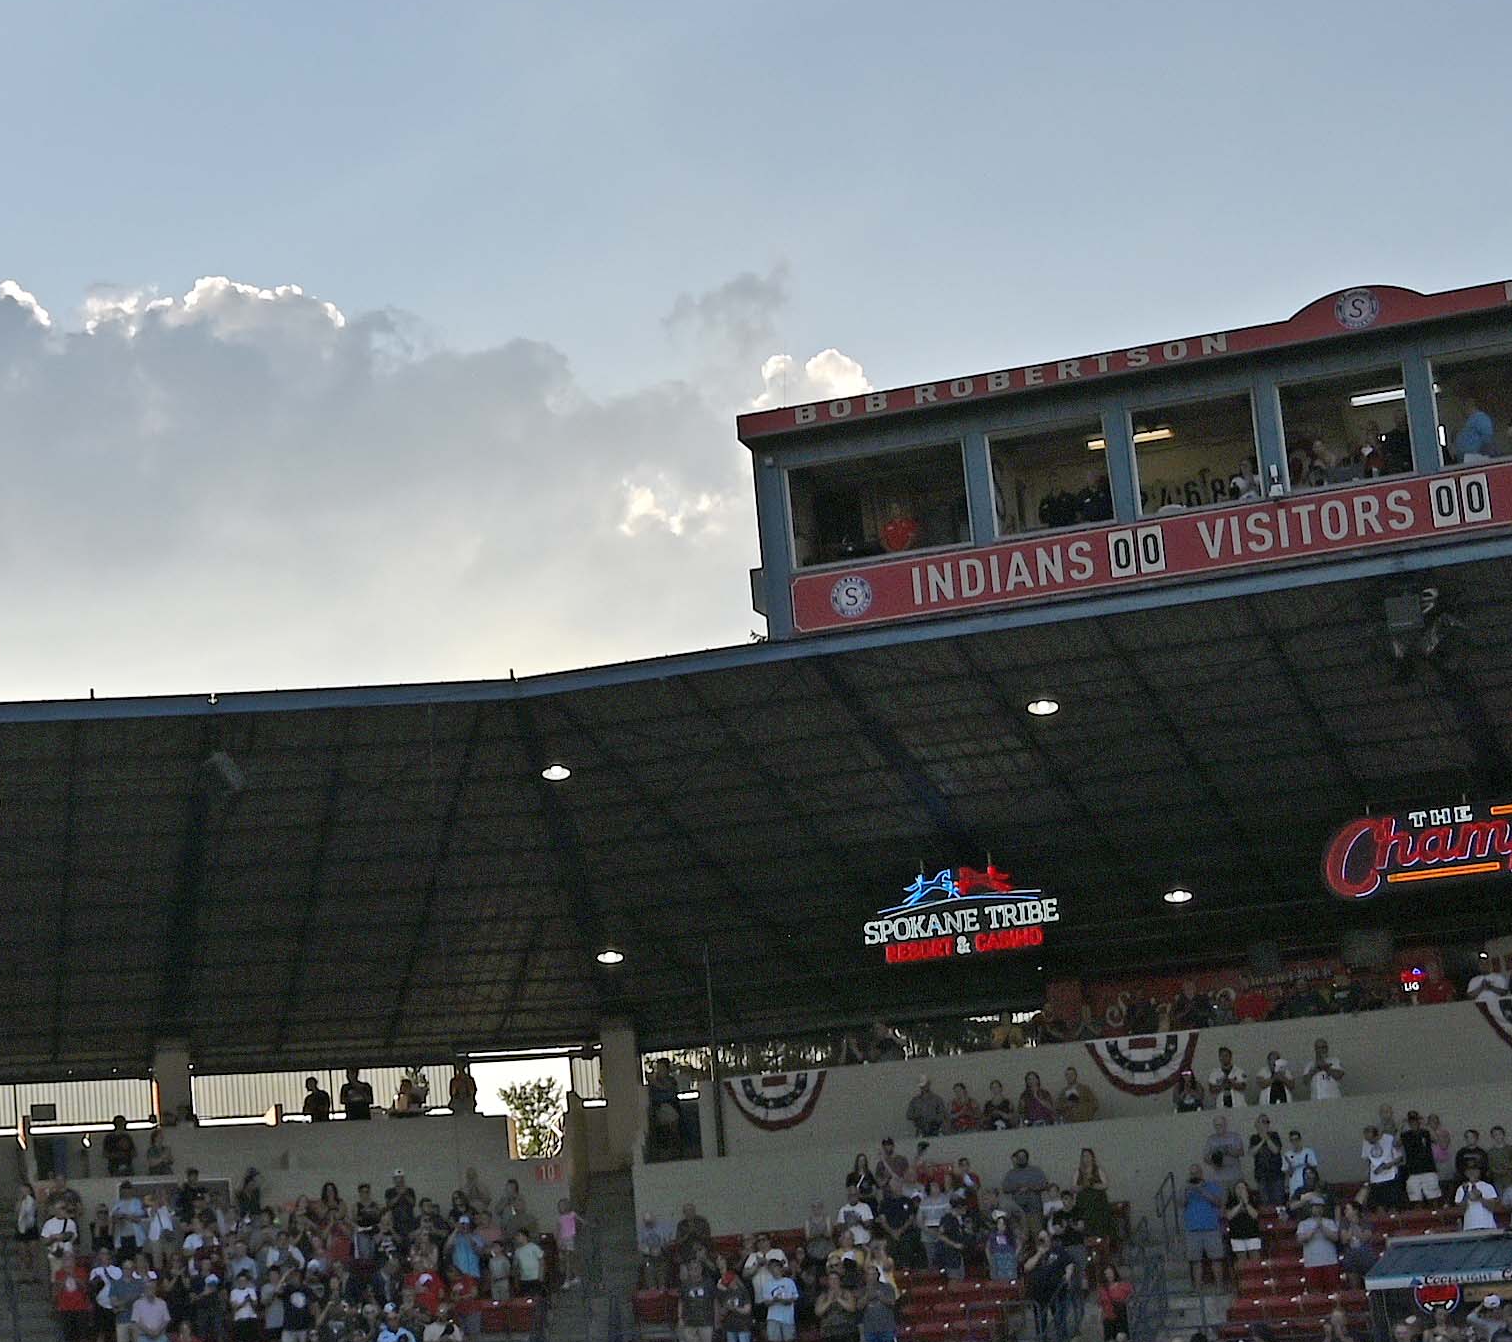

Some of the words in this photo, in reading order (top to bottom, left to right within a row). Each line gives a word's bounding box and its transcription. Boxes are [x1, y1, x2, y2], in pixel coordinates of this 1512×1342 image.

[795, 394, 887, 424] BOB
[914, 333, 1228, 405] ROBERTSON
[1436, 479, 1487, 520] 00
[1196, 489, 1415, 560] VISITORS
[911, 541, 1094, 604] INDIANS
[1112, 529, 1160, 573] 00
[1408, 804, 1473, 828] THE
[863, 908, 980, 945] SPOKANE
[984, 897, 1060, 929] TRIBE
[884, 936, 953, 964] RESORT
[955, 935, 971, 955] &
[974, 925, 1045, 953] CASINO
[541, 1165, 555, 1180] 10
